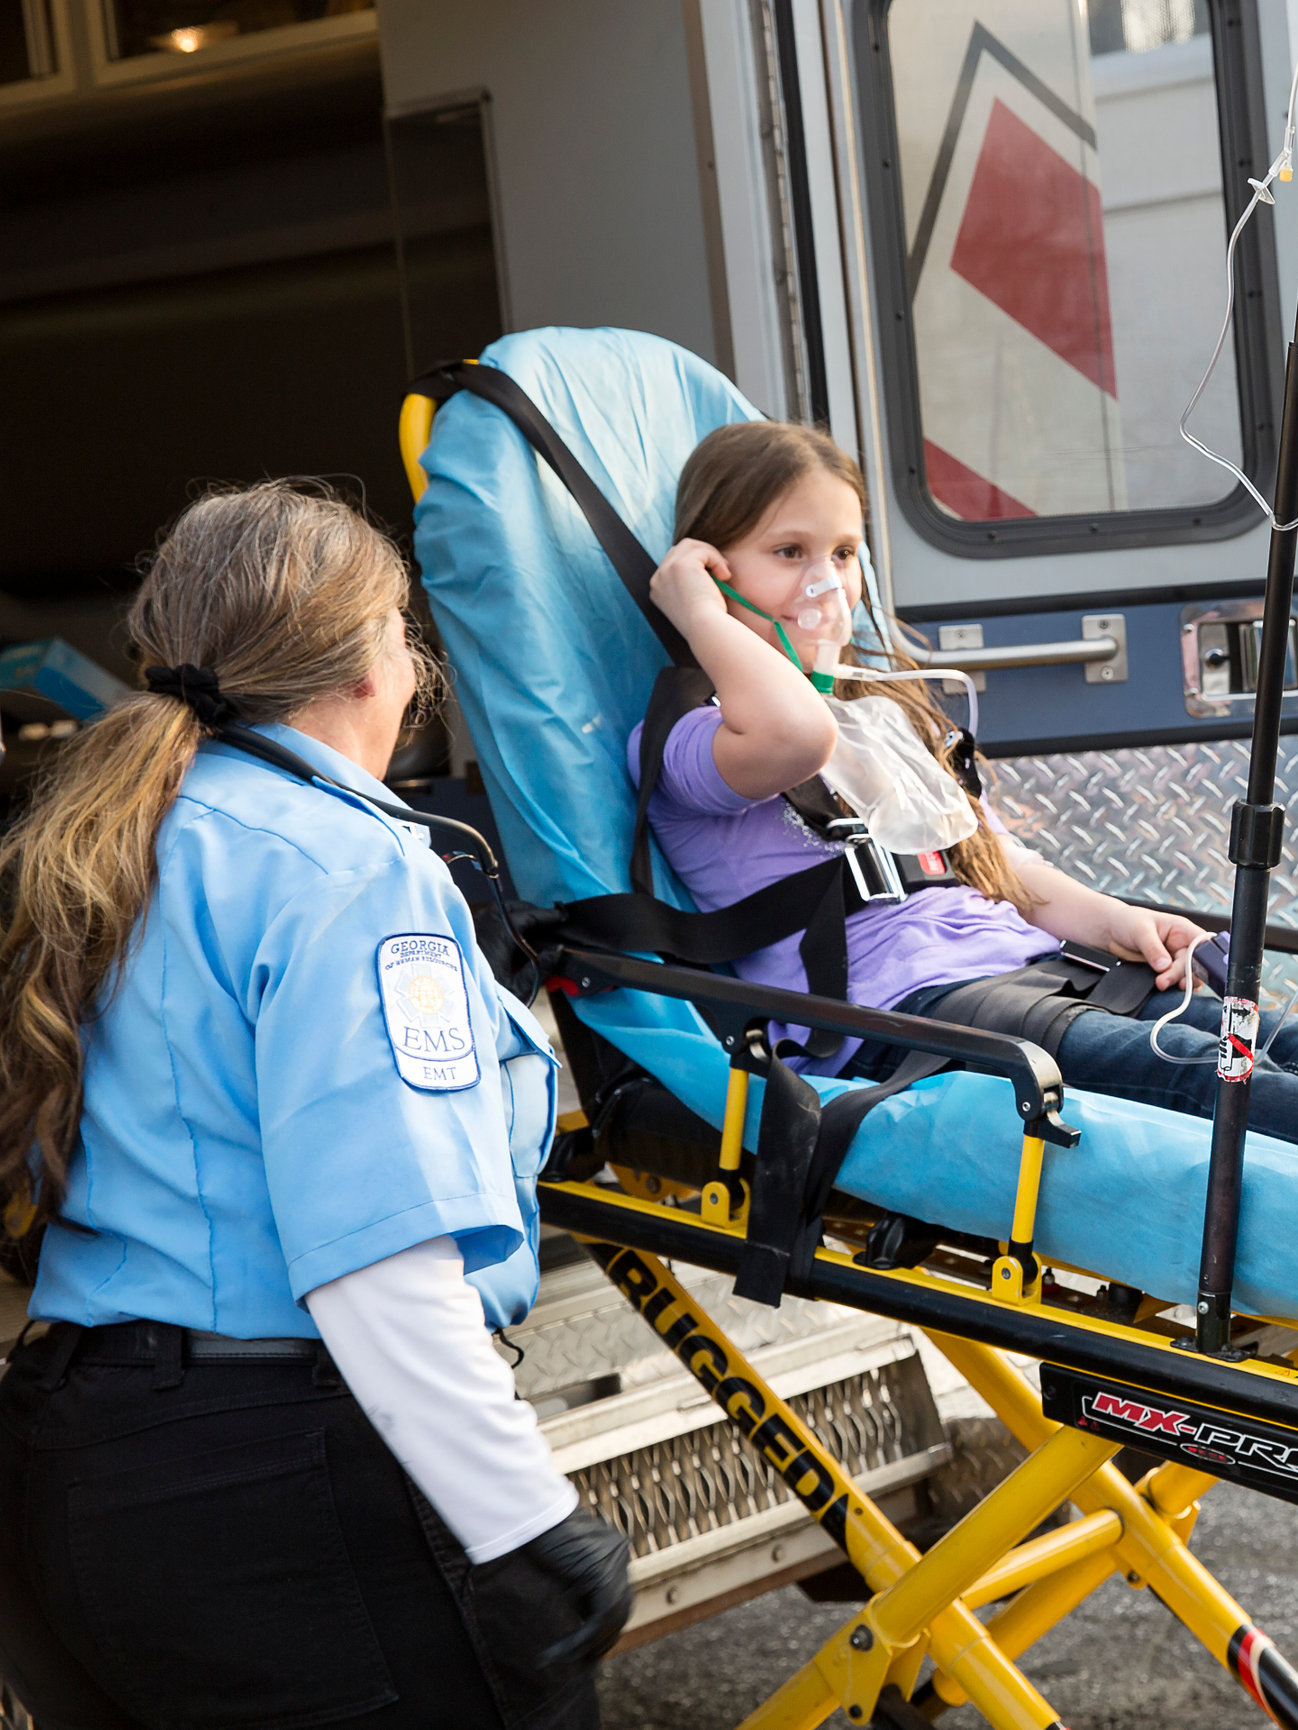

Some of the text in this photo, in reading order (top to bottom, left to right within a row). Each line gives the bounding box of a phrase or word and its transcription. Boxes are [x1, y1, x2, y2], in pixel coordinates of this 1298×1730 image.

[391, 940, 450, 956] GEORGIA
[402, 1026, 466, 1053] EMS
[423, 1066, 457, 1081] EMT
[606, 1248, 836, 1513] RUGGED
